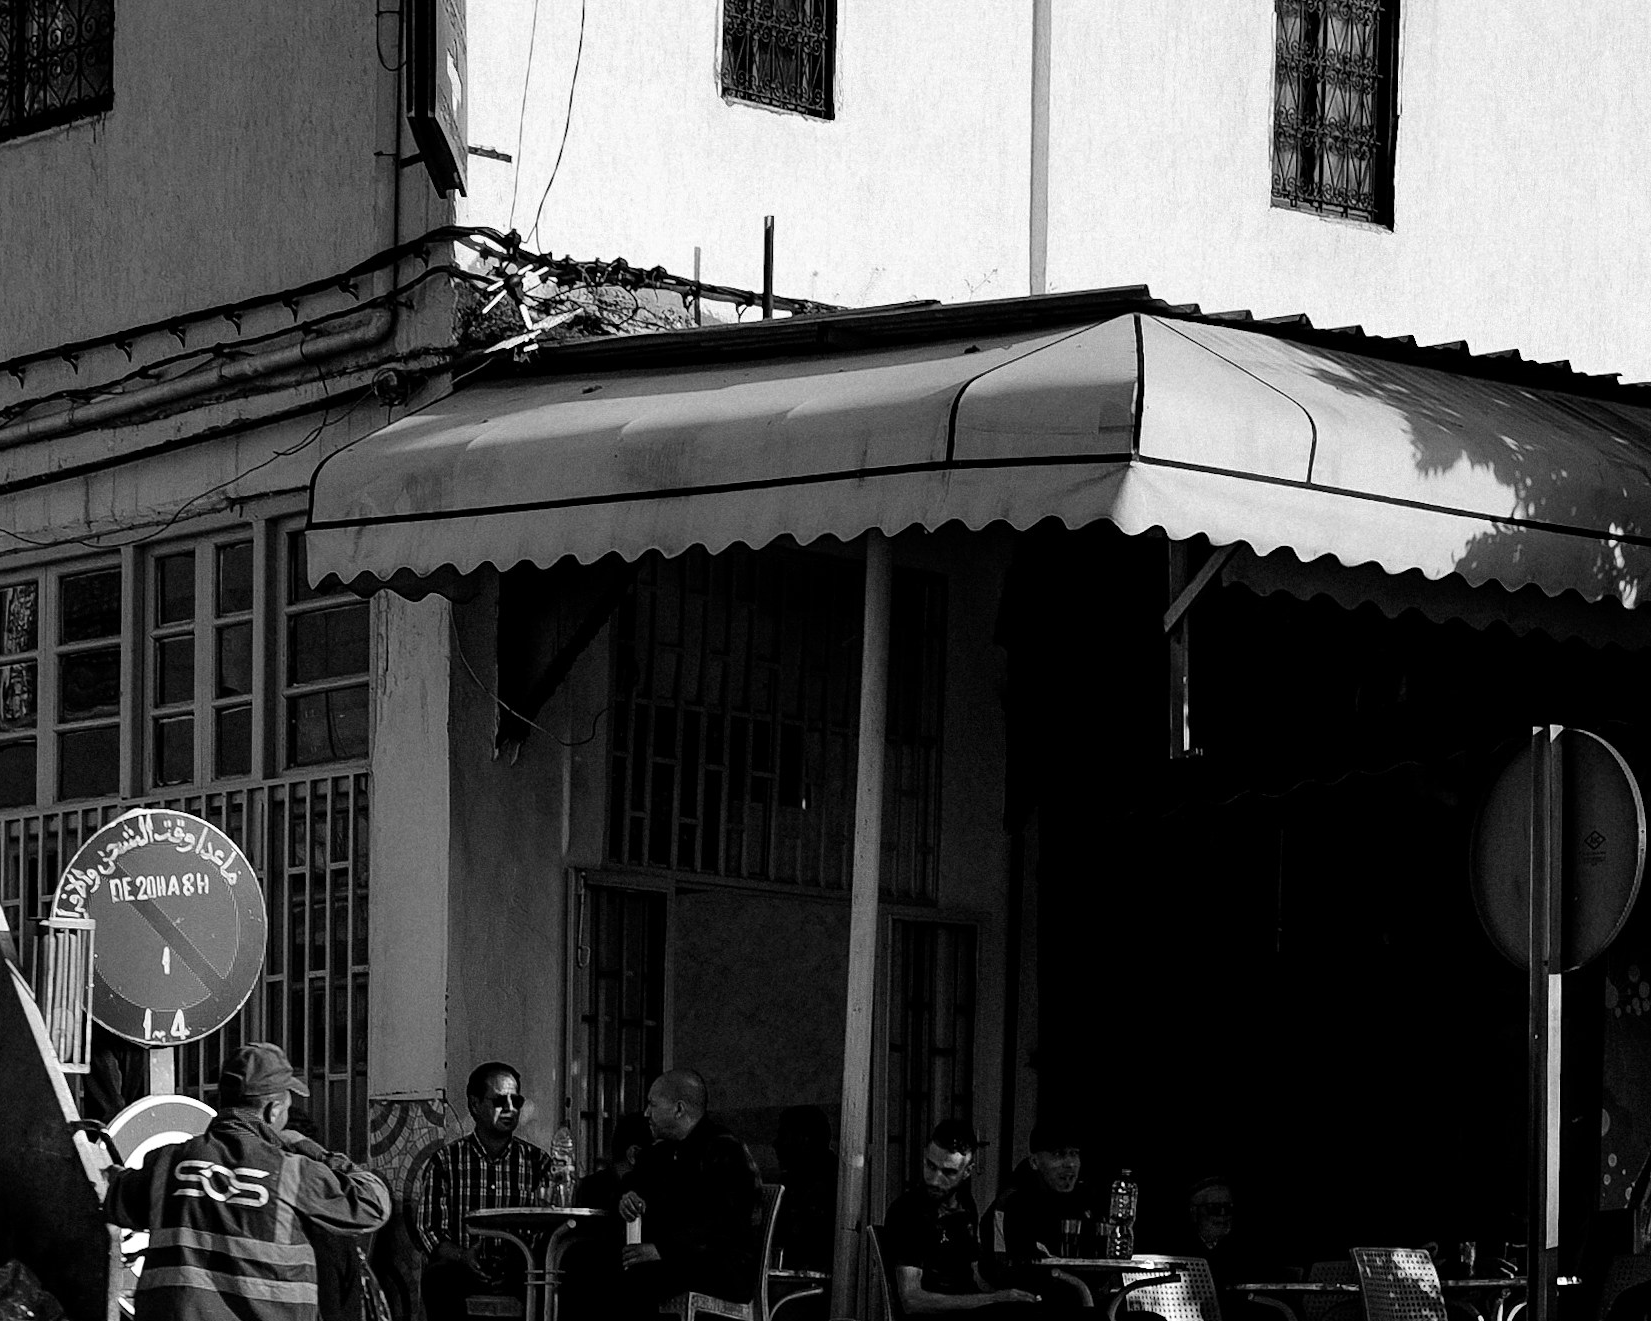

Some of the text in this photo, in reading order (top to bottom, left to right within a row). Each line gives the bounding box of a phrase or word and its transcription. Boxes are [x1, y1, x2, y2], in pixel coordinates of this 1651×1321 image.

[109, 872, 209, 904] DE 20H A 8H
[172, 1160, 270, 1208] SOS
